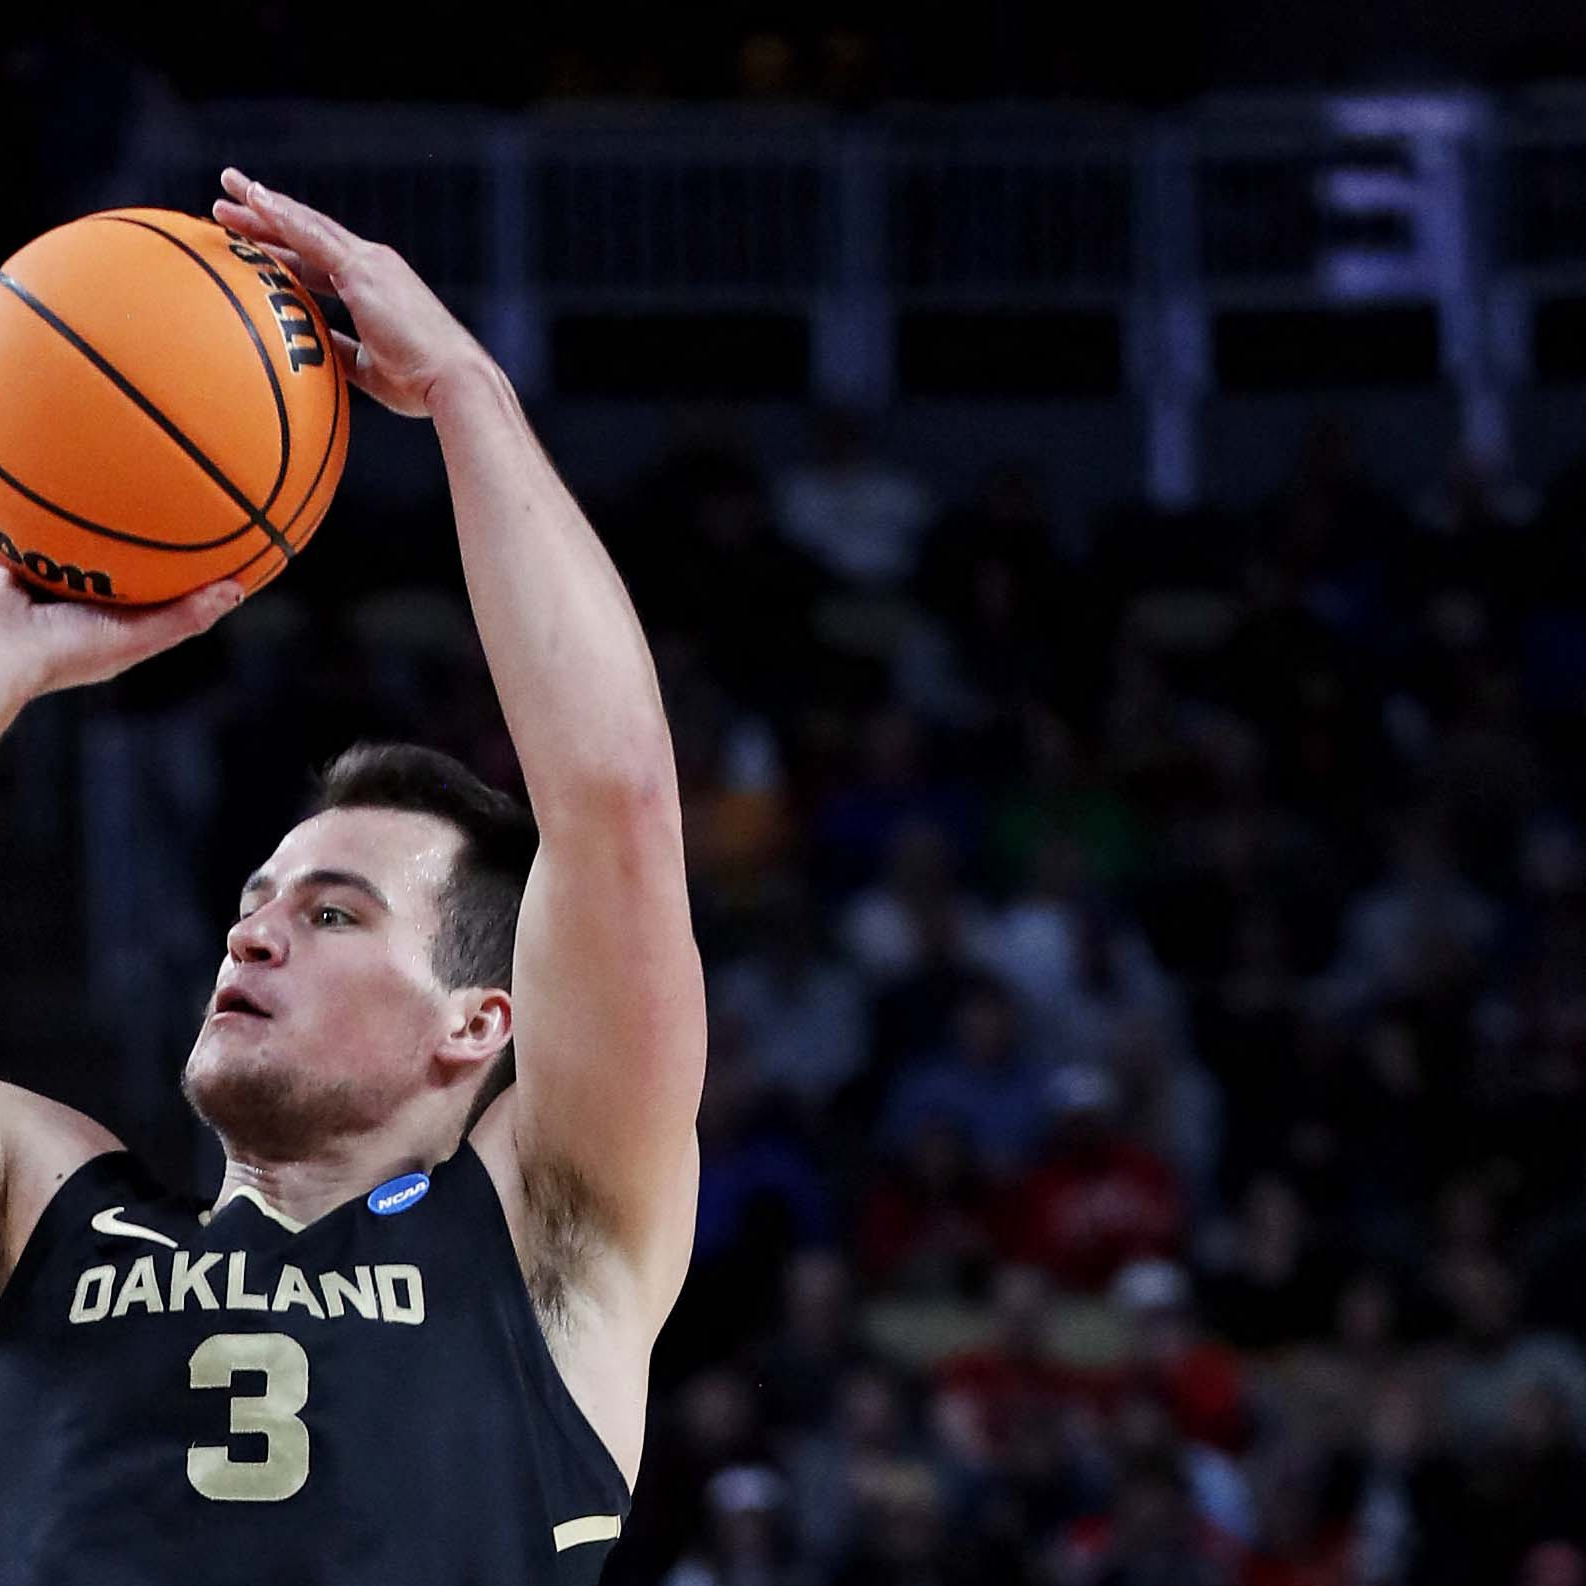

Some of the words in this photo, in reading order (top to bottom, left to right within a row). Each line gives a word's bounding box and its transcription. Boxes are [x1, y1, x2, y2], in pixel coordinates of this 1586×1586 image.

[378, 1181, 427, 1210] NCAA
[68, 1249, 426, 1325] OAKLAND
[186, 1331, 311, 1501] 3
